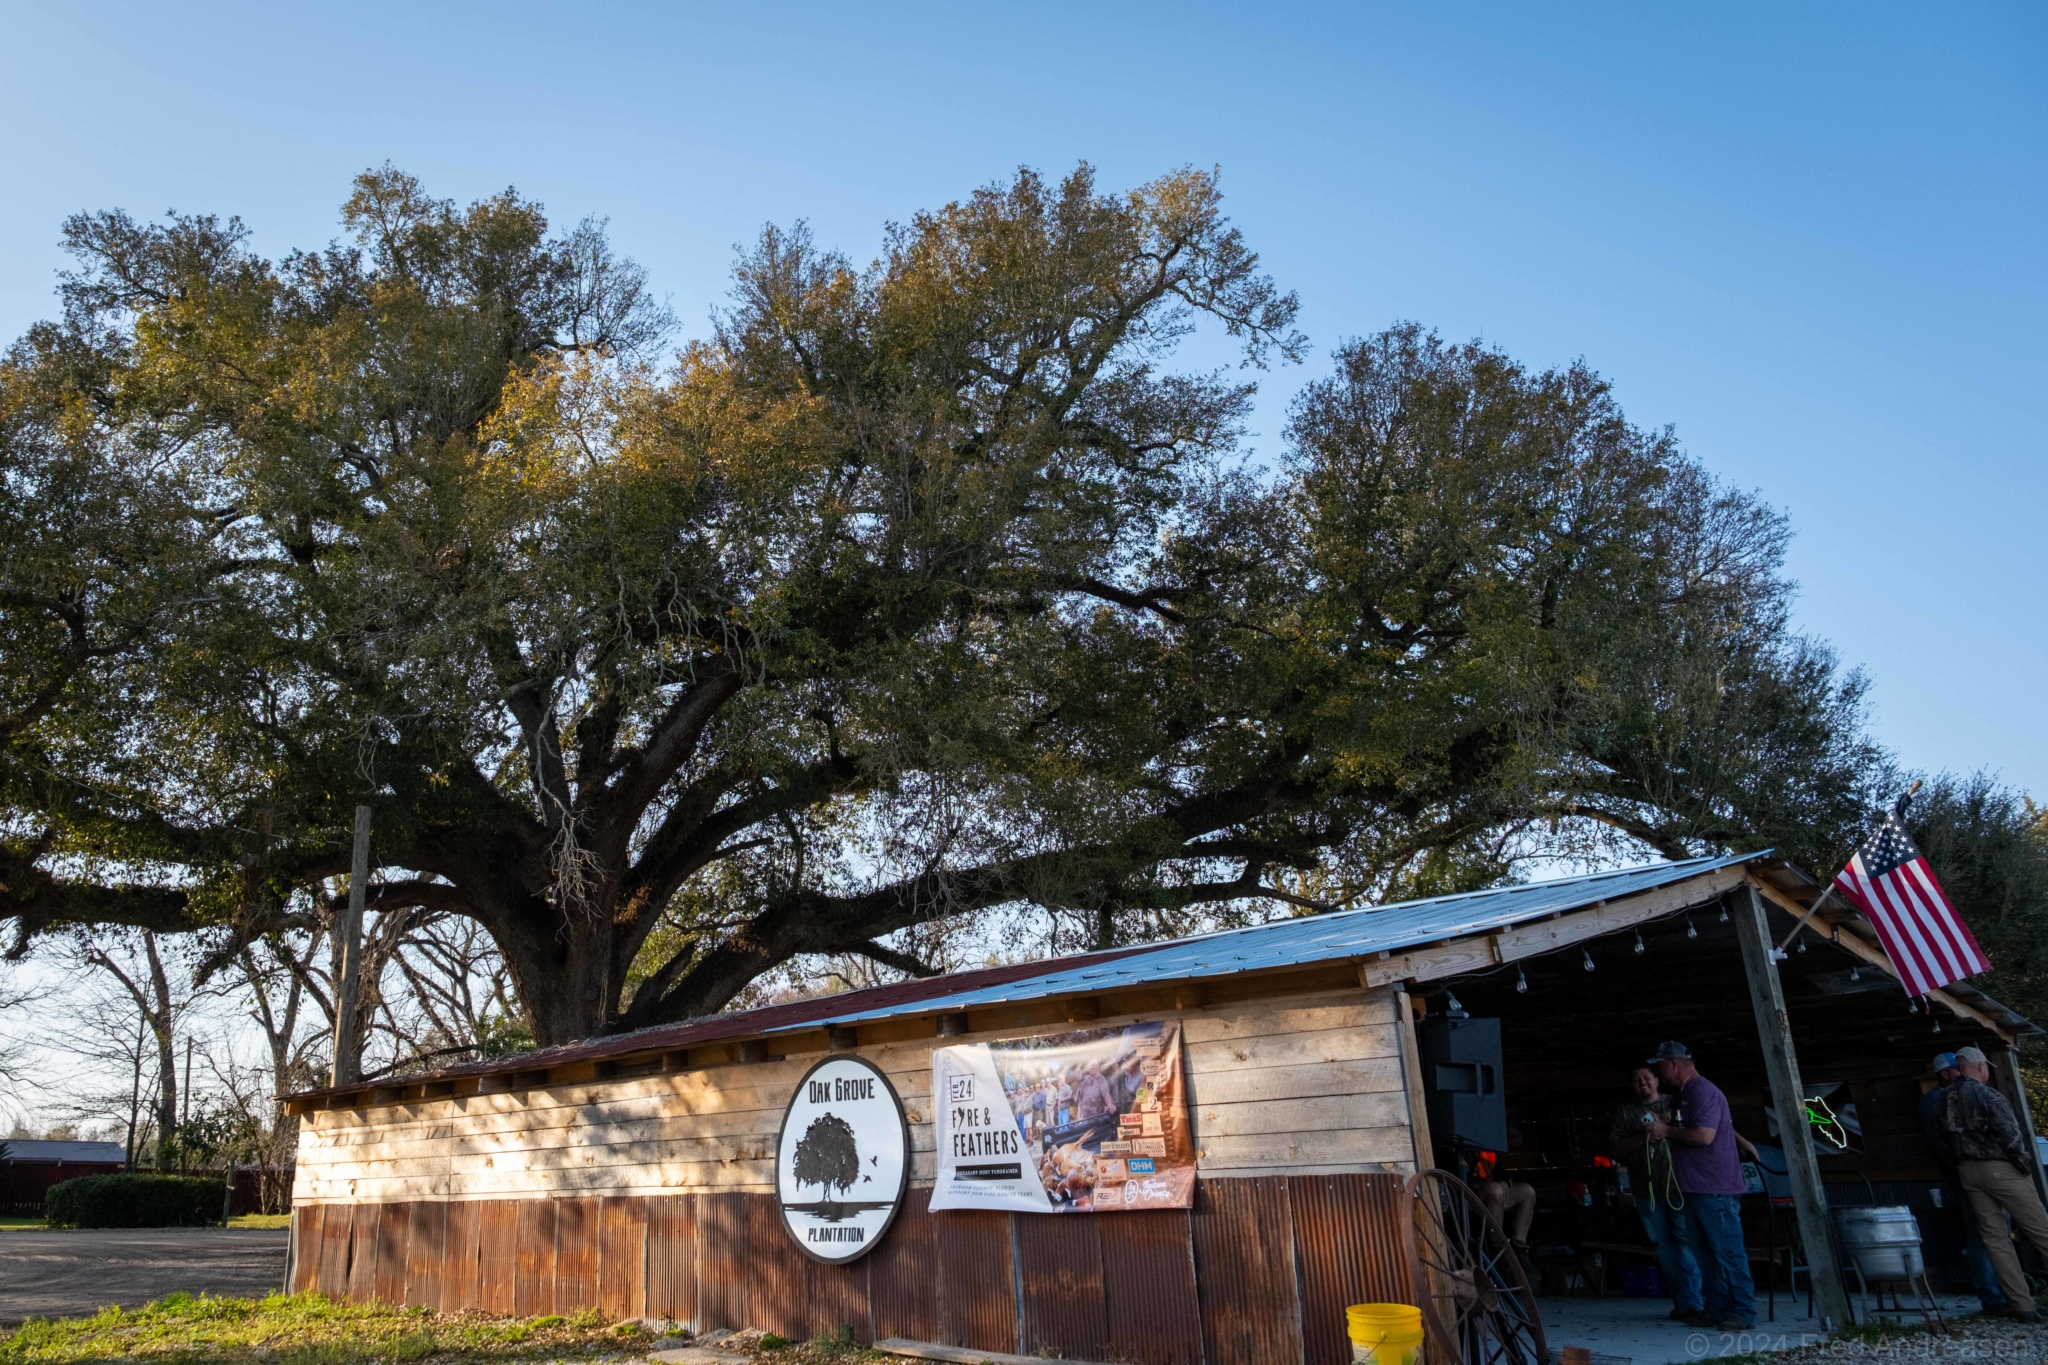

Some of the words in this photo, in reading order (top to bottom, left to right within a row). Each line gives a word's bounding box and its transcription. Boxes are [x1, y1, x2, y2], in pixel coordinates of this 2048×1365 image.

[809, 1081, 831, 1104] OAK
[835, 1078, 875, 1101] GROVE
[959, 1079, 972, 1098] 24
[984, 1107, 991, 1126] &
[954, 1129, 1018, 1157] FEATHERS
[1130, 1161, 1153, 1171] DHM
[1142, 1179, 1166, 1190] Jackson
[1144, 1188, 1170, 1201] County
[808, 1227, 865, 1242] PLANTATION
